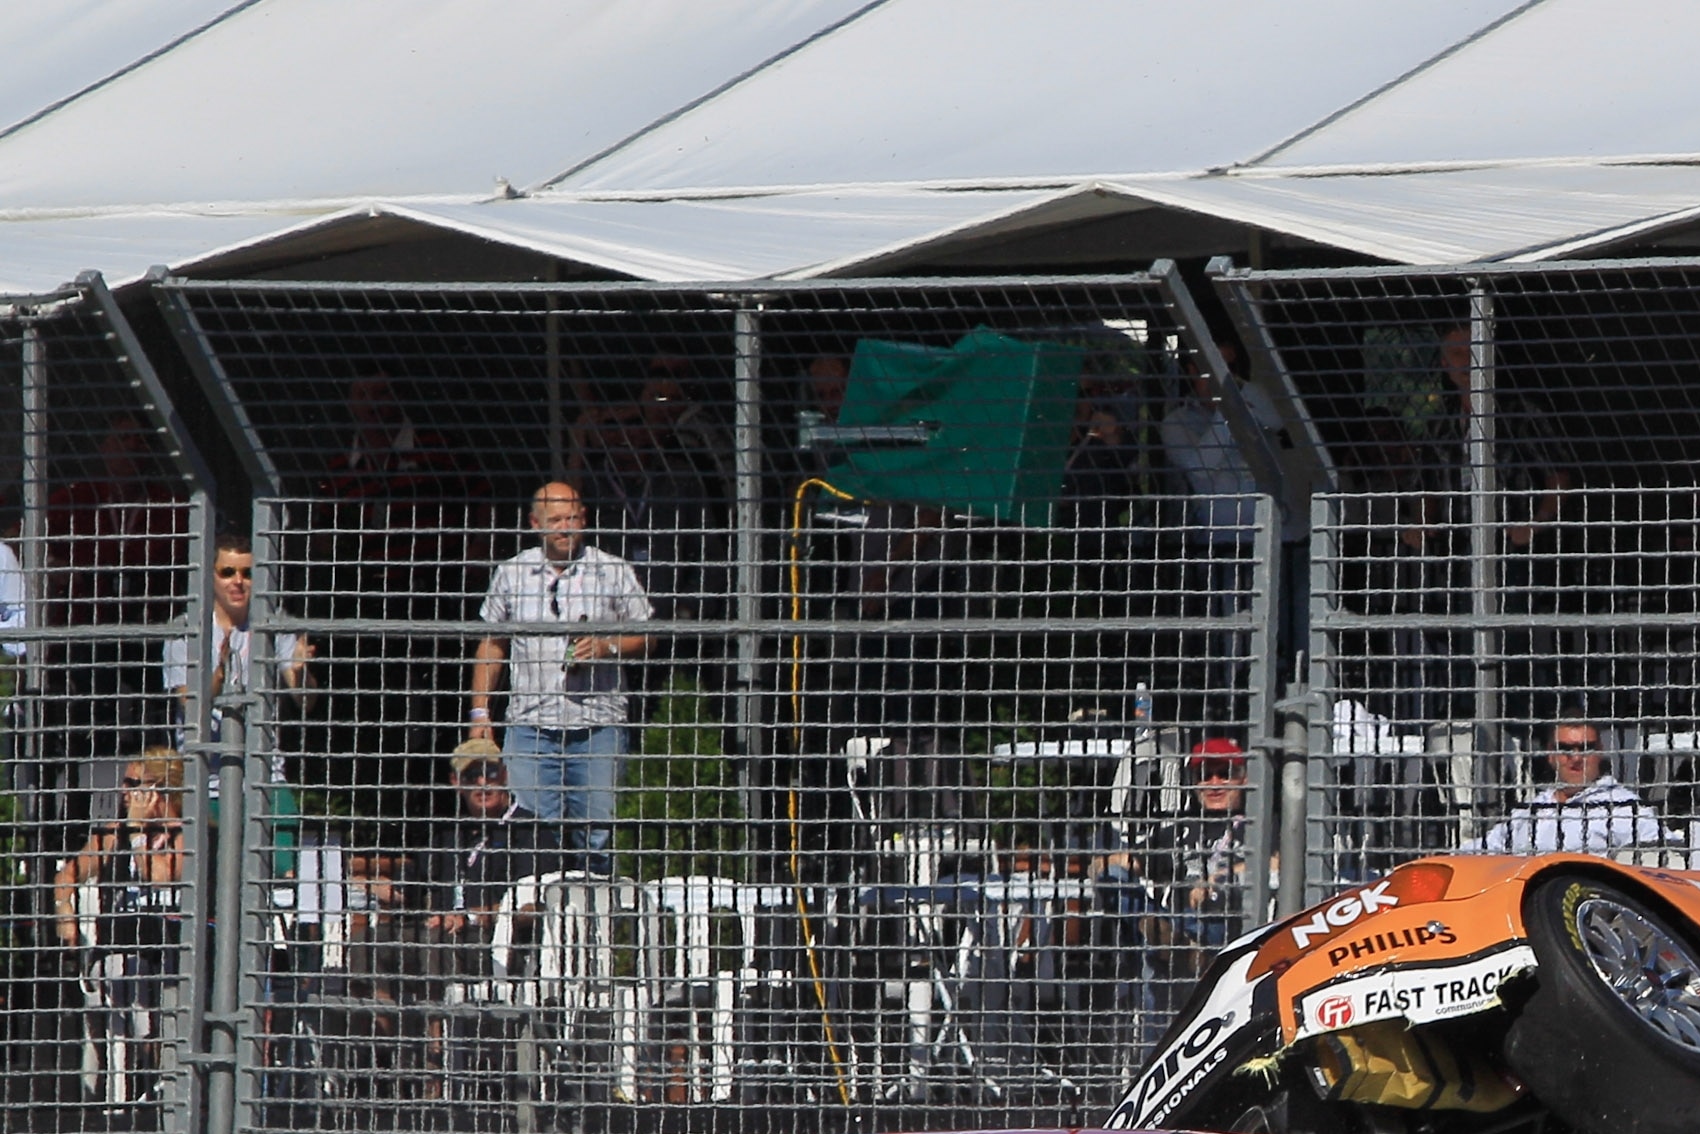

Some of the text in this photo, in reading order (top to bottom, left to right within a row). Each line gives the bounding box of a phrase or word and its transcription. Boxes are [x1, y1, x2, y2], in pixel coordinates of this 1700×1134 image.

[1292, 880, 1399, 949] NGK
[1328, 926, 1458, 967] PHILIPS
[1364, 986, 1427, 1016] FAST
